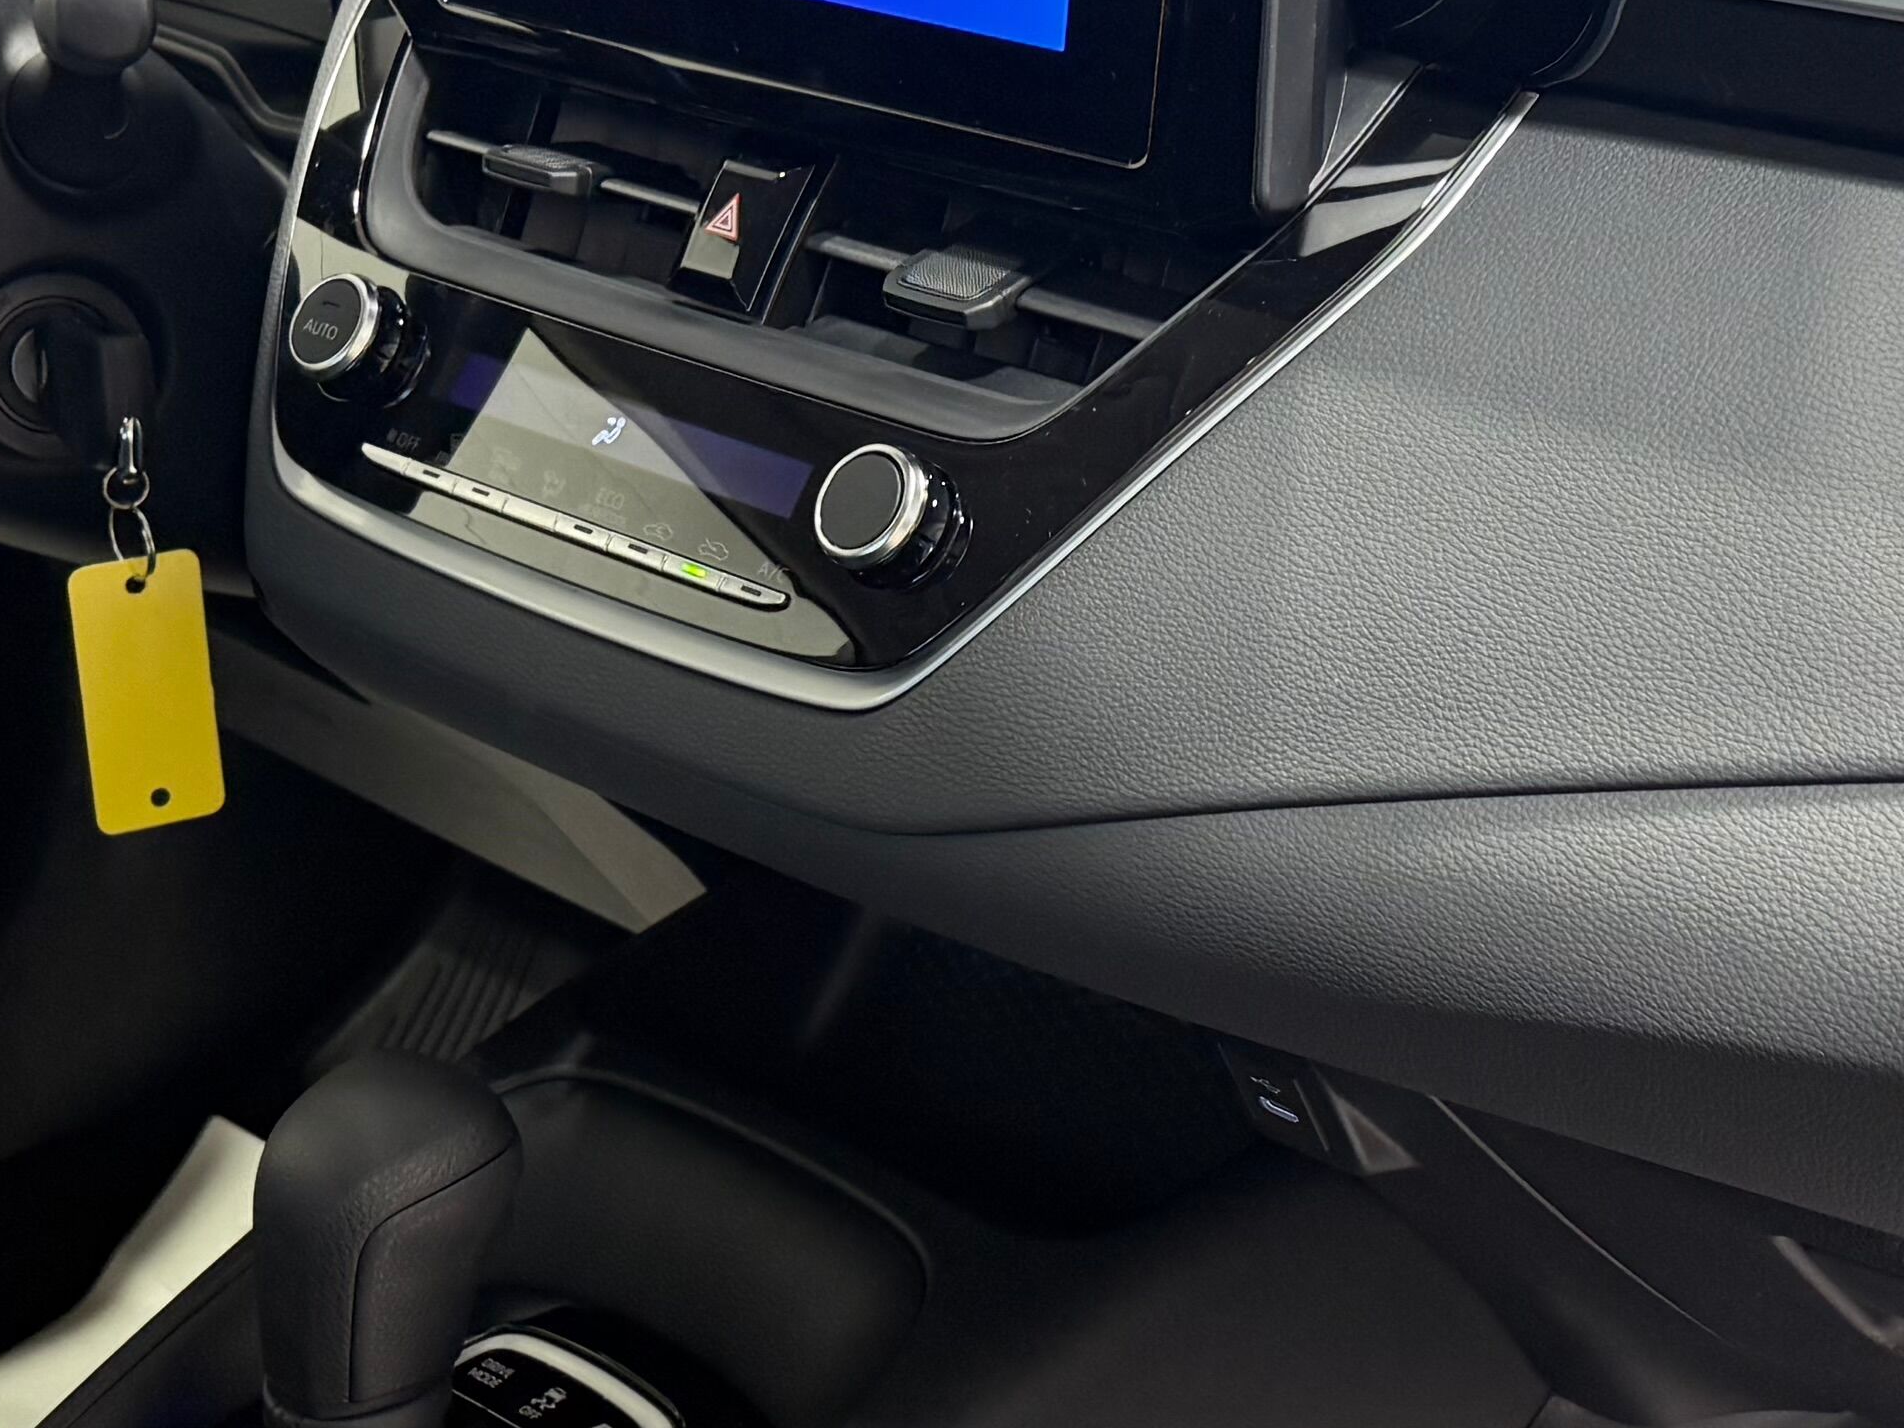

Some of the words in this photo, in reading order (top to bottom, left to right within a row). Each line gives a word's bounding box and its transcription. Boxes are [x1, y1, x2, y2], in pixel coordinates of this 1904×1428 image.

[302, 317, 339, 341] AUTO
[396, 431, 421, 451] OFF
[757, 560, 792, 584] A/C
